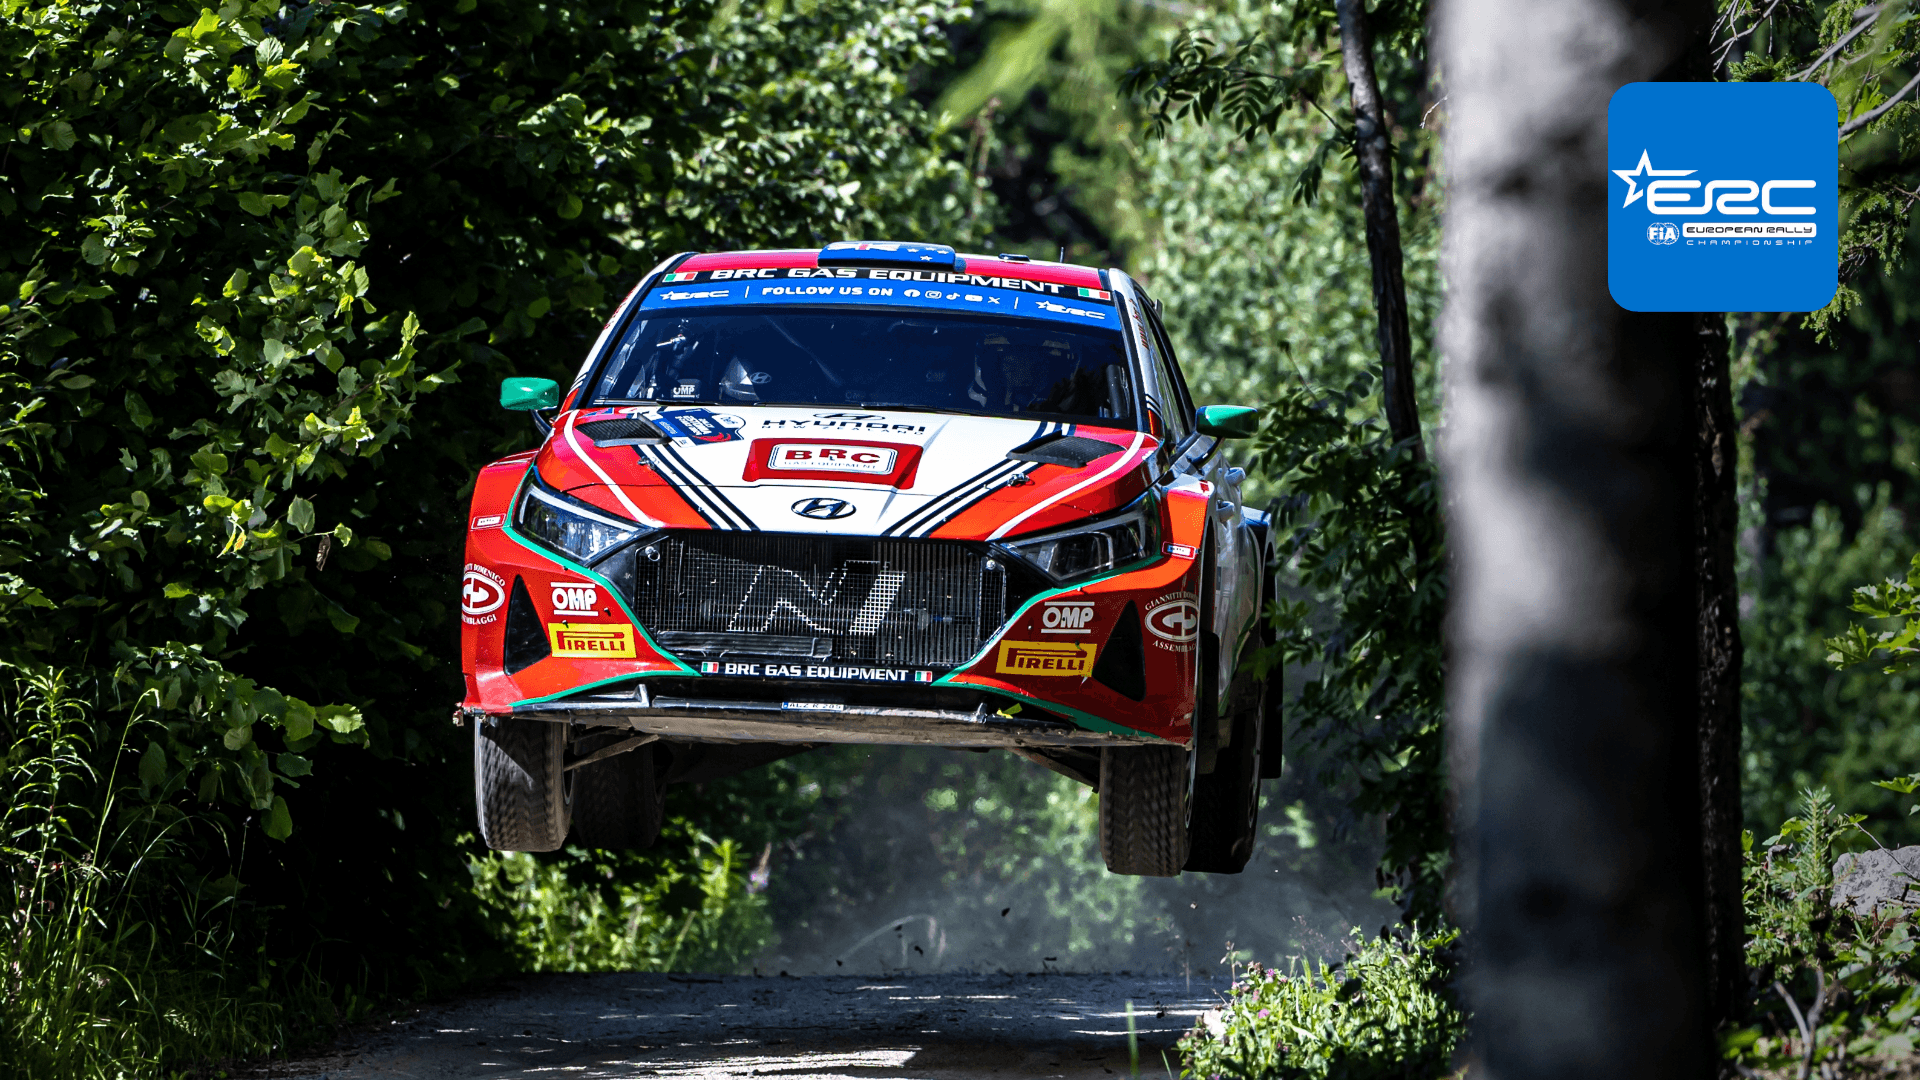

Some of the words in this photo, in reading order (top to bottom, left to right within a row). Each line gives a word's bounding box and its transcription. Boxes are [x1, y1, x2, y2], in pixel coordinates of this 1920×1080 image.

[710, 268, 778, 280] BRC
[787, 268, 858, 279] GAS
[869, 269, 1065, 294] EQUIPMENT
[762, 286, 834, 296] FOLLOW
[838, 286, 863, 296] US
[868, 287, 894, 297] ON
[763, 420, 927, 433] HYUNDAI
[785, 448, 881, 464] BRC
[552, 588, 597, 610] OMP
[1042, 606, 1094, 628] OMP
[556, 631, 626, 651] PIRELLI
[1005, 647, 1088, 671] PIRELLI
[725, 662, 760, 676] BRC
[765, 664, 802, 677] GAS
[807, 665, 909, 681] EQUIPMENT
